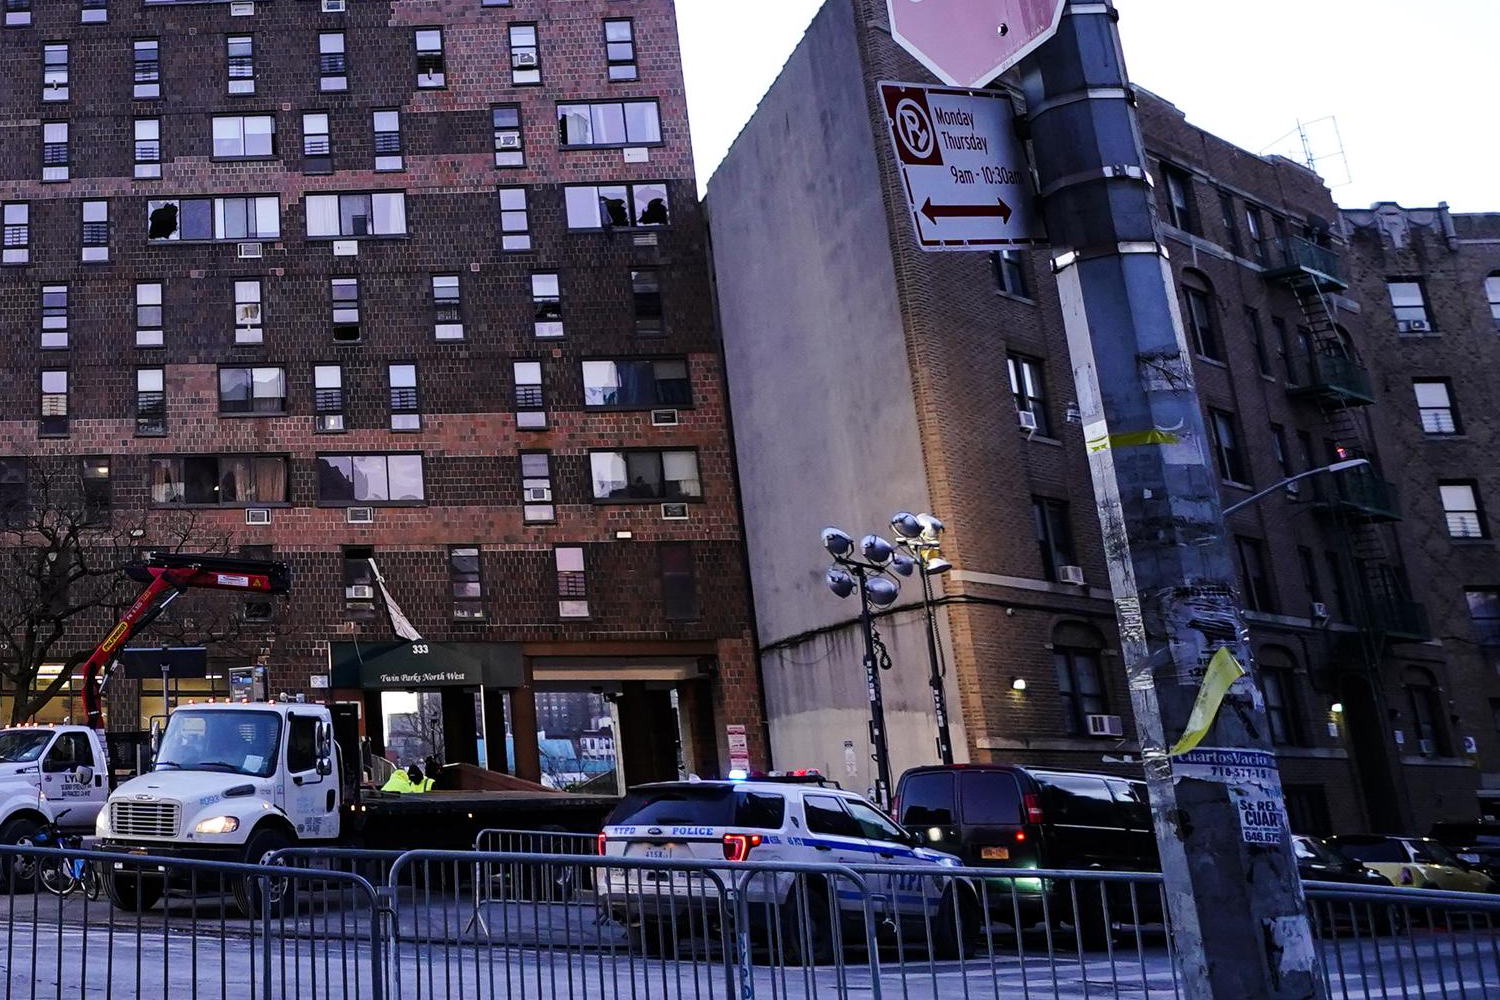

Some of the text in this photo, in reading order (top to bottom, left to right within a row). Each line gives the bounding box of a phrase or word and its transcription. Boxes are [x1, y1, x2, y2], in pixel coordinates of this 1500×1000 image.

[933, 106, 975, 131] Monday
[941, 131, 989, 155] Thursday
[950, 165, 975, 184] 9am
[981, 166, 1024, 185] 10:30am
[412, 644, 429, 654] 333
[380, 671, 465, 682] Twin Parks North West
[1240, 800, 1254, 810] SE
[614, 827, 636, 835] NYPD
[672, 826, 714, 836] POLICE
